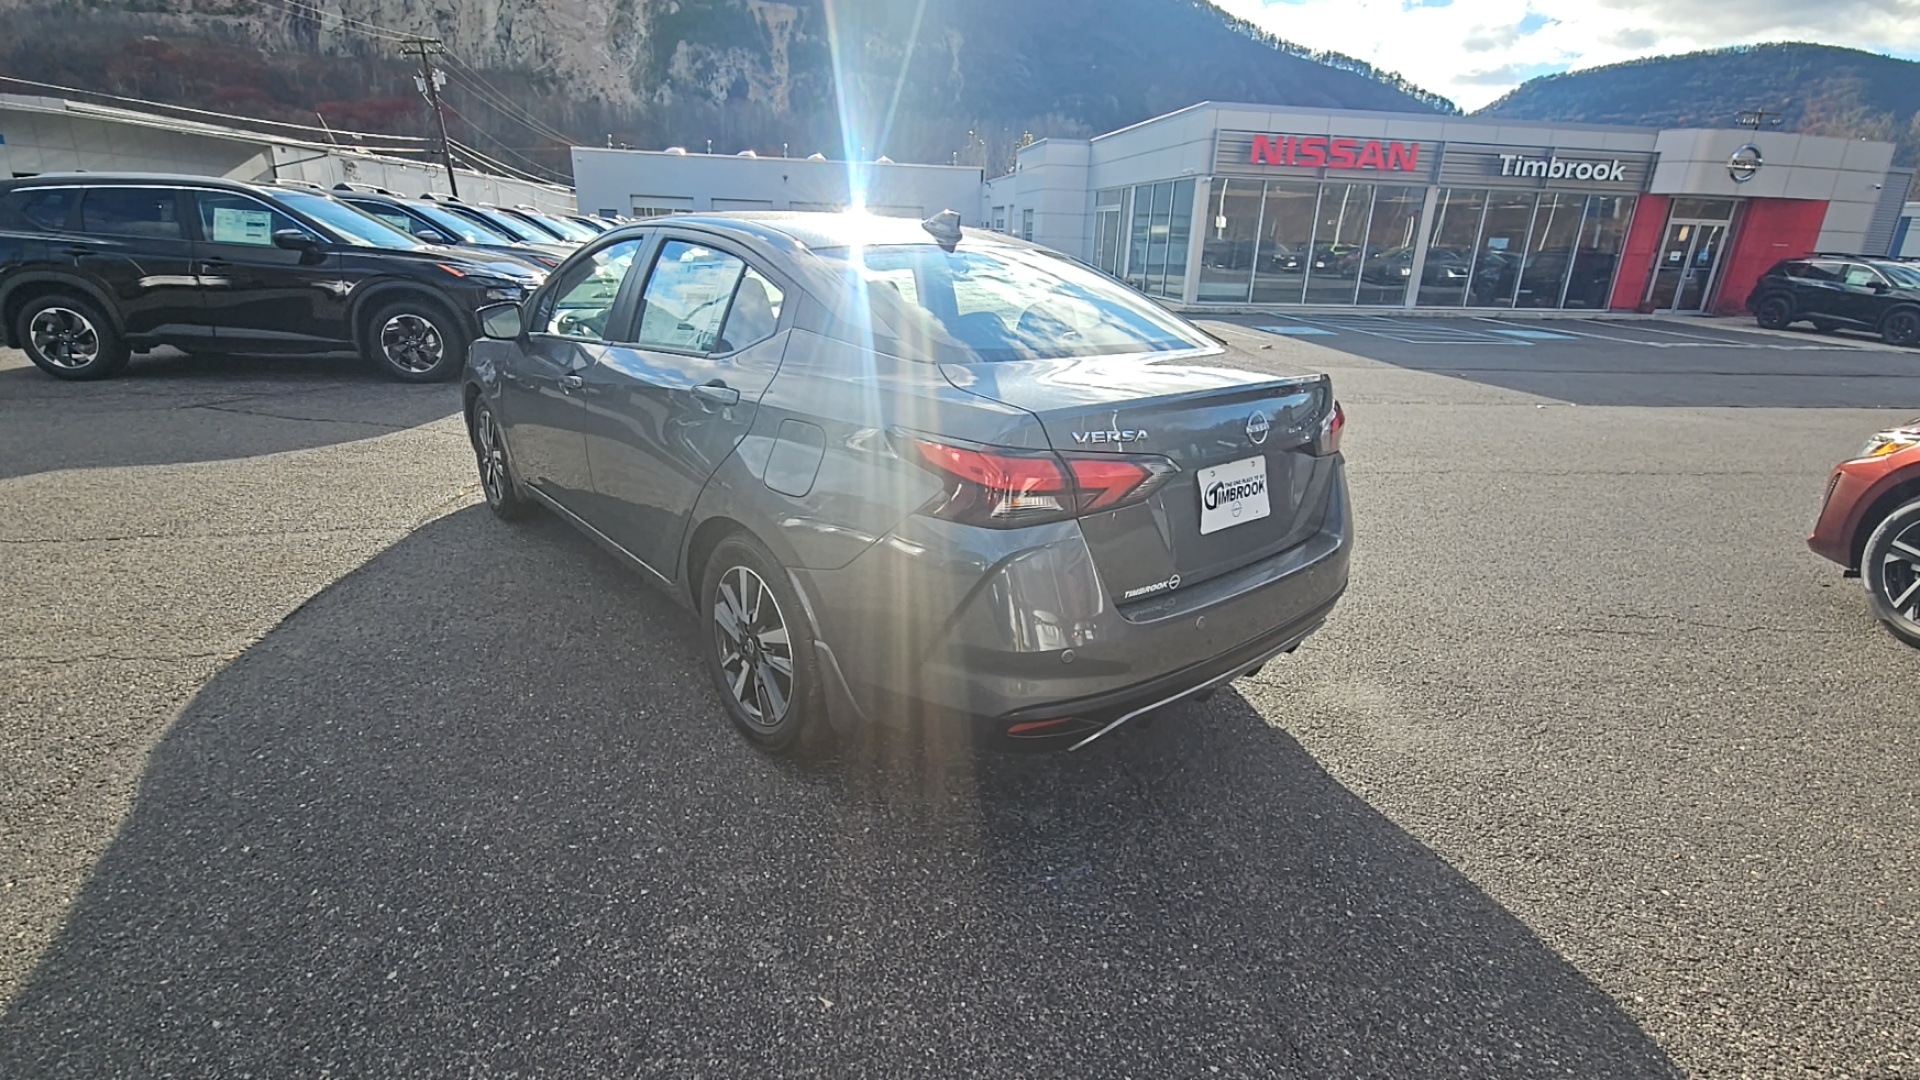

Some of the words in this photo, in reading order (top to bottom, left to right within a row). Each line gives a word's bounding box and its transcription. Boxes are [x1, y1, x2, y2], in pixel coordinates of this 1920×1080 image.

[1251, 134, 1420, 173] NISSAN
[1499, 154, 1627, 181] Timbrook
[1071, 429, 1149, 444] VERSA
[1204, 480, 1265, 510] TIMBROOK
[1124, 580, 1169, 599] TIMBROOK
